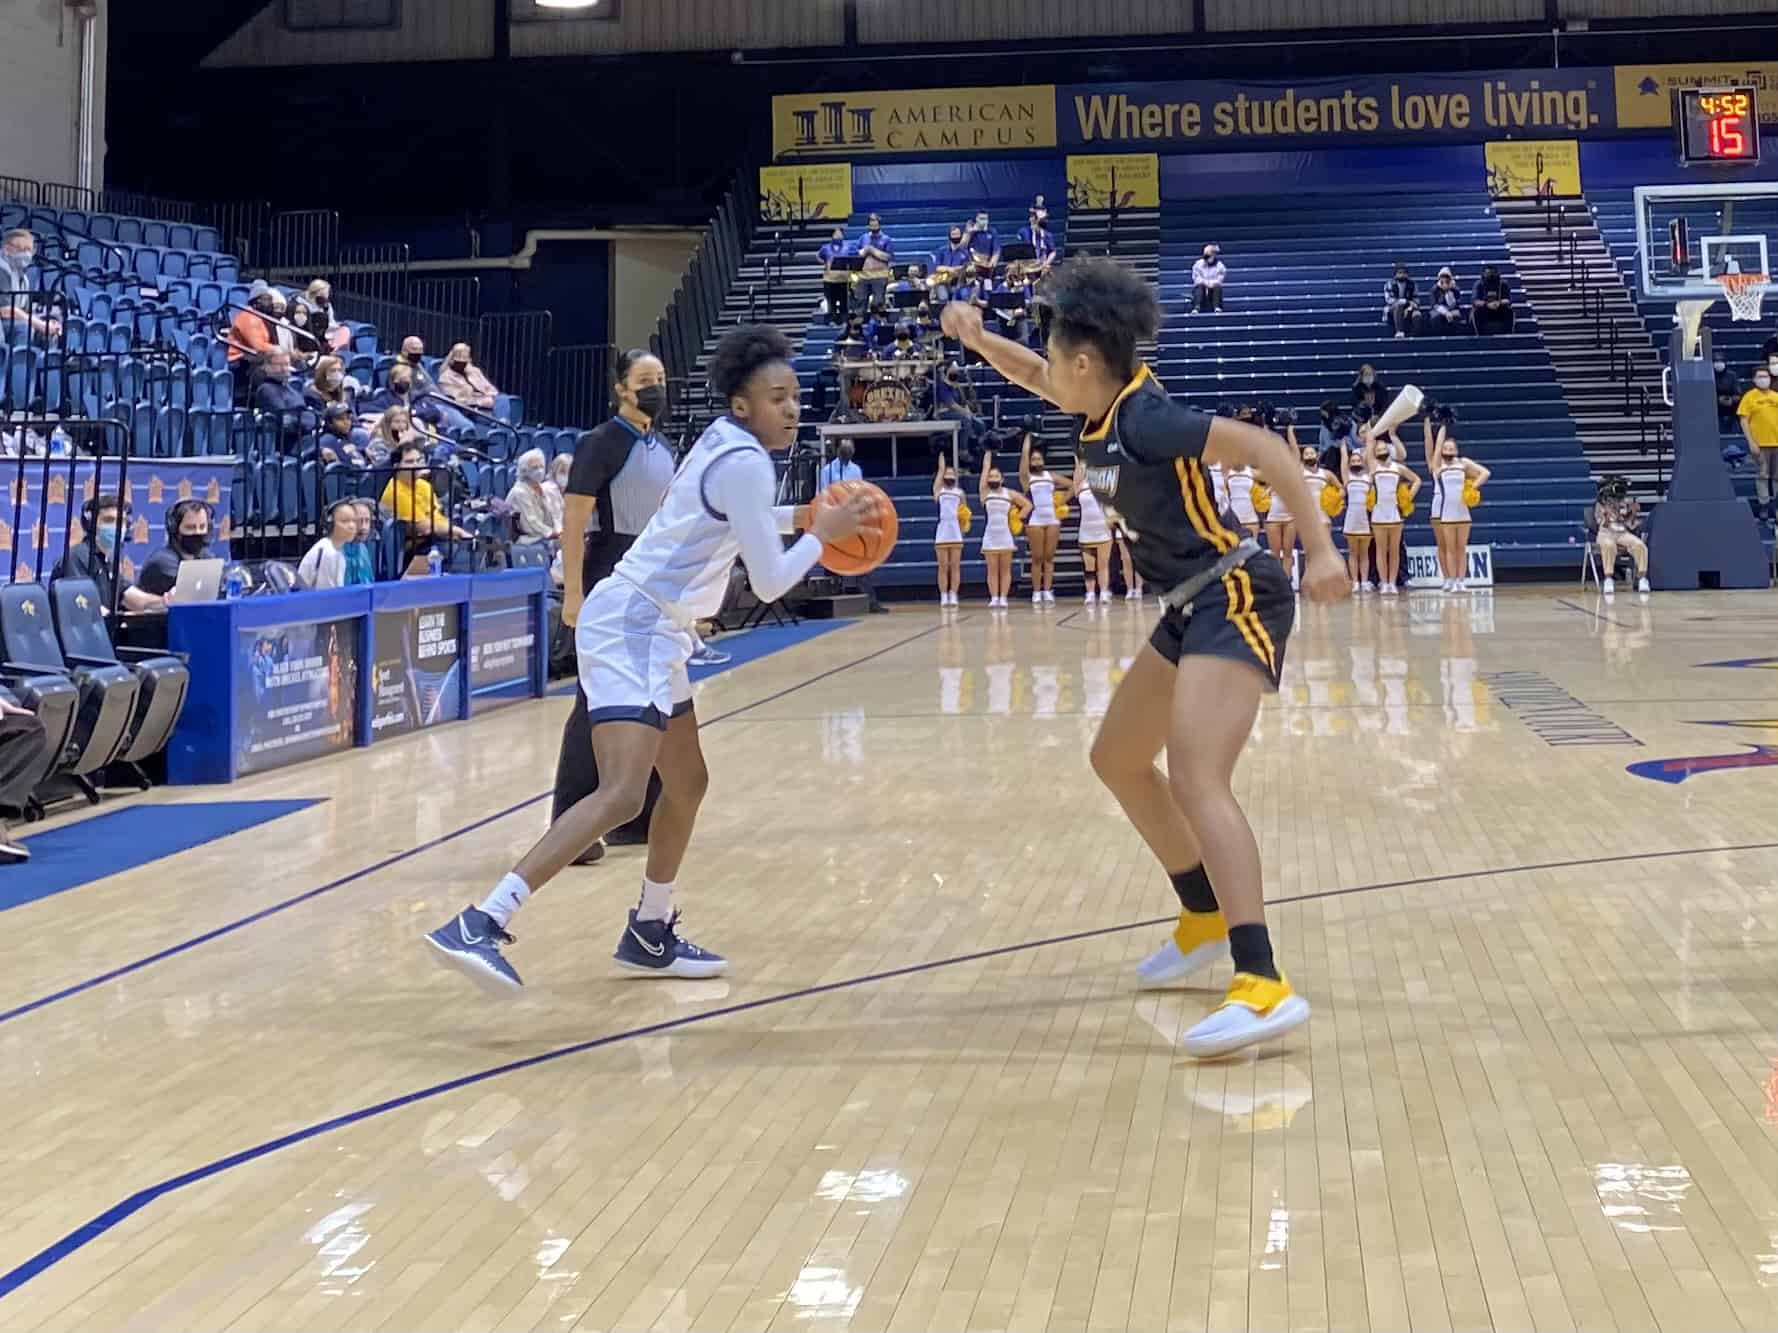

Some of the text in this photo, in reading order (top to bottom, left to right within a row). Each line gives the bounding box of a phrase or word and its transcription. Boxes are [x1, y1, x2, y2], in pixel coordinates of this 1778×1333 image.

[887, 102, 1036, 125] AMERICAN
[1075, 80, 1599, 141] Where students love living.
[1701, 94, 1748, 116] 4:52
[886, 126, 1036, 150] CAMPUS
[1711, 116, 1744, 155] 15
